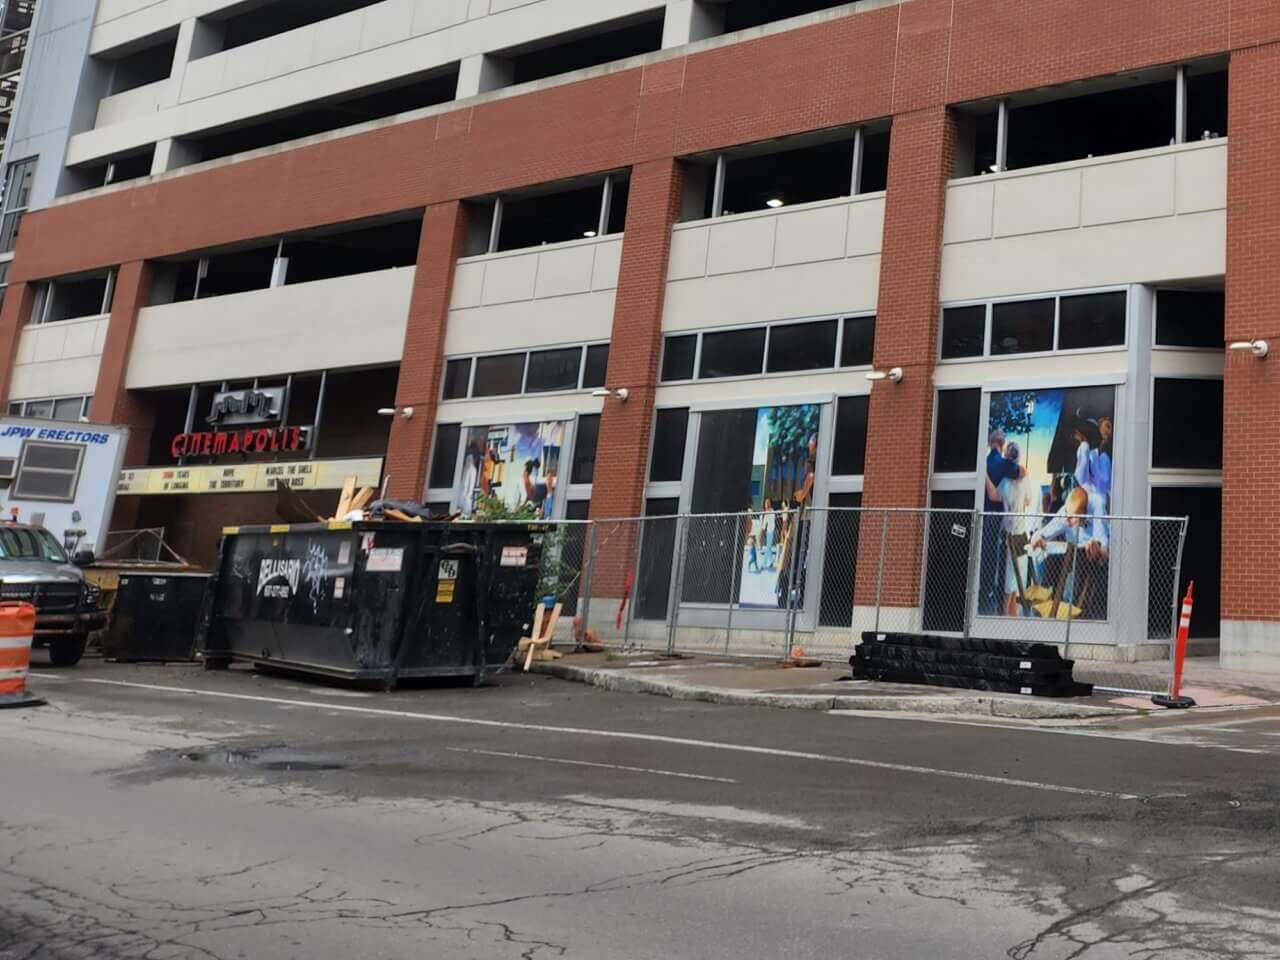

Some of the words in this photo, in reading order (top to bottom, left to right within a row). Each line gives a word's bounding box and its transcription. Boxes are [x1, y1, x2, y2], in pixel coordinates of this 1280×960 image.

[1, 426, 35, 438] JPW
[37, 429, 110, 445] ERECTORS
[170, 426, 301, 457] CINEMAPOLIS
